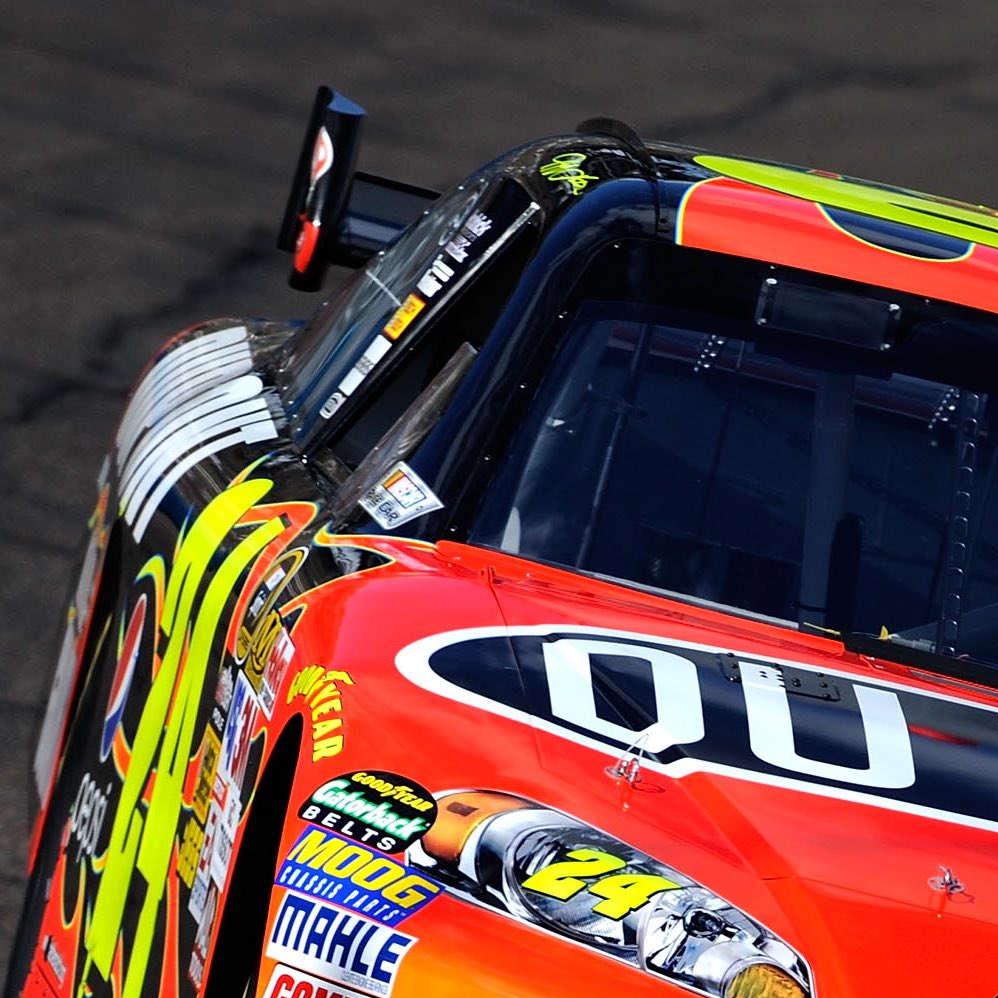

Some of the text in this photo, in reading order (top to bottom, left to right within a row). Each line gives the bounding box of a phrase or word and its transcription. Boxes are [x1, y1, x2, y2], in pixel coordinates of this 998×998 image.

[311, 778, 425, 841] Gatorback
[351, 772, 434, 812] GOODYEAR
[302, 806, 396, 850] BELTS
[279, 865, 395, 922] CHASSIS PARTS
[286, 829, 440, 910] MOOG
[521, 848, 684, 921] 24
[271, 893, 414, 985] MAHLE
